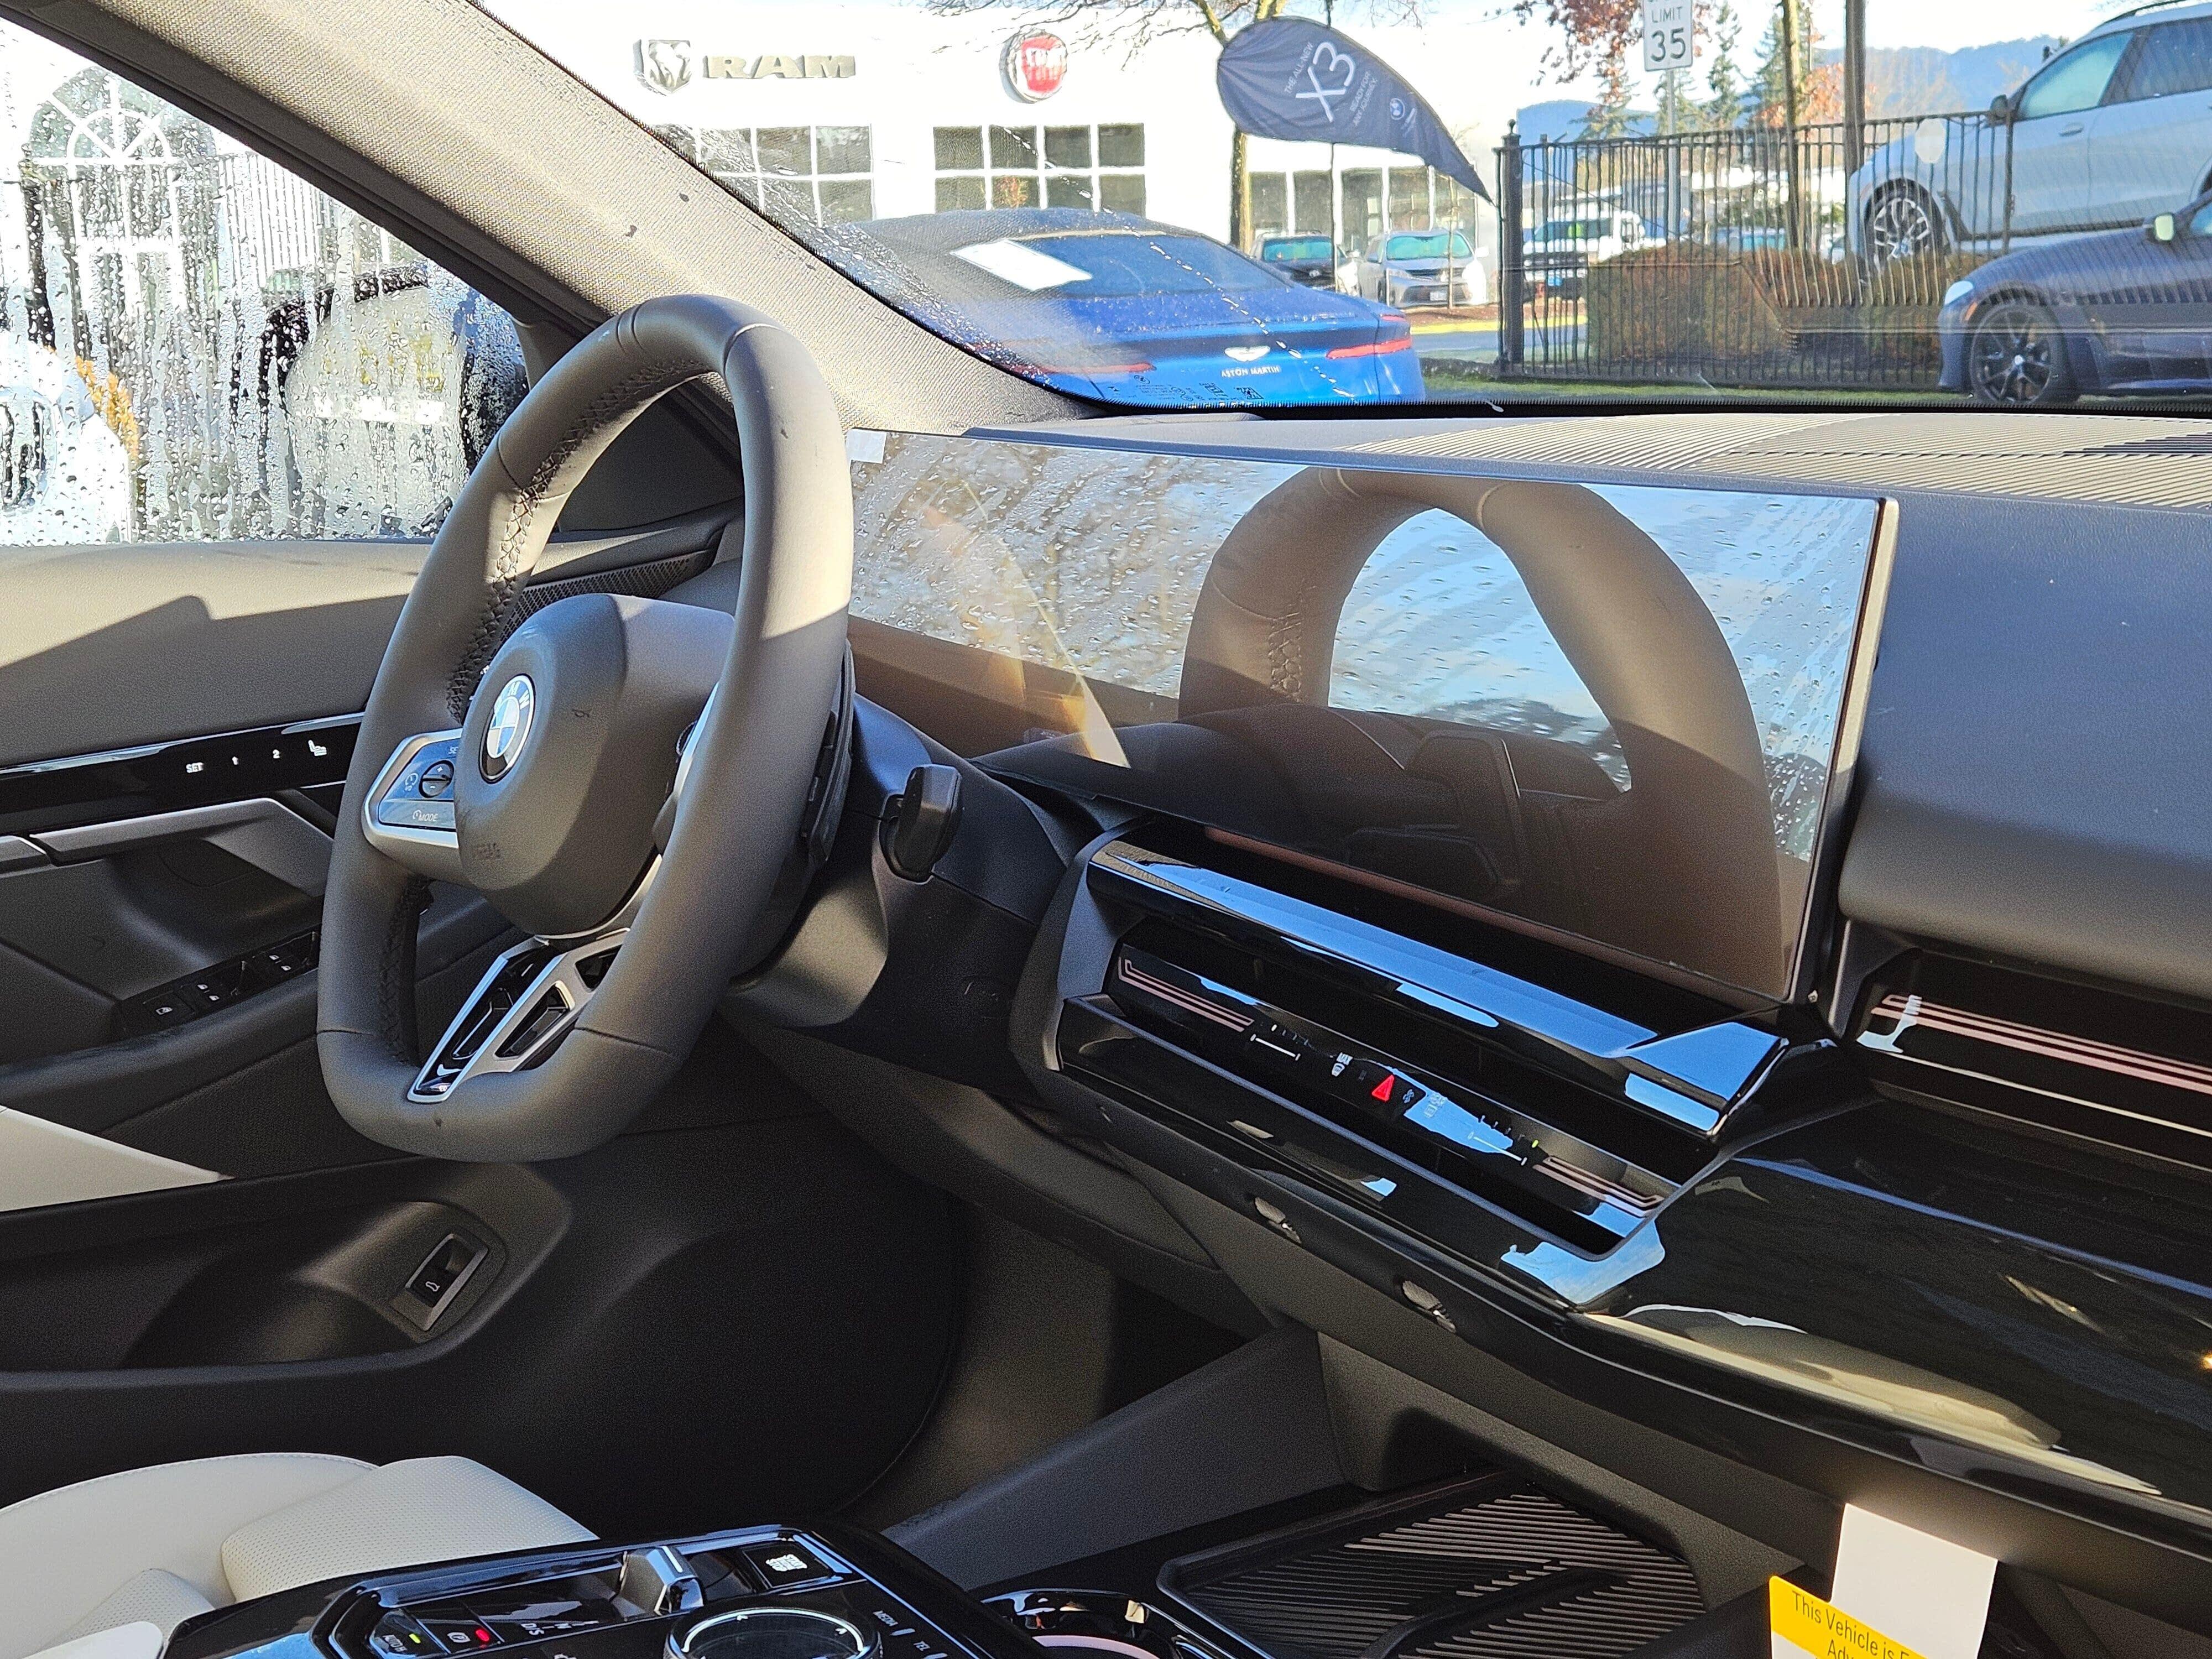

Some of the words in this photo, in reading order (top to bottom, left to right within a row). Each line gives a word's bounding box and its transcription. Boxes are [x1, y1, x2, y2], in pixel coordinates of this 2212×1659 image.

[1651, 7, 1683, 23] LIMIT
[1651, 27, 1686, 62] 35
[704, 55, 856, 80] RAM
[1284, 76, 1297, 93] THE
[1295, 42, 1355, 122] X3
[1221, 368, 1248, 378] ASTON
[1250, 366, 1281, 375] MARTIN
[232, 756, 238, 765] 1
[273, 749, 280, 759] 2
[186, 762, 204, 773] SET
[1337, 1052, 1353, 1066] MAX
[1792, 1590, 1821, 1624] This
[1825, 1609, 1877, 1656] Vehicle
[1883, 1641, 1894, 1659] is
